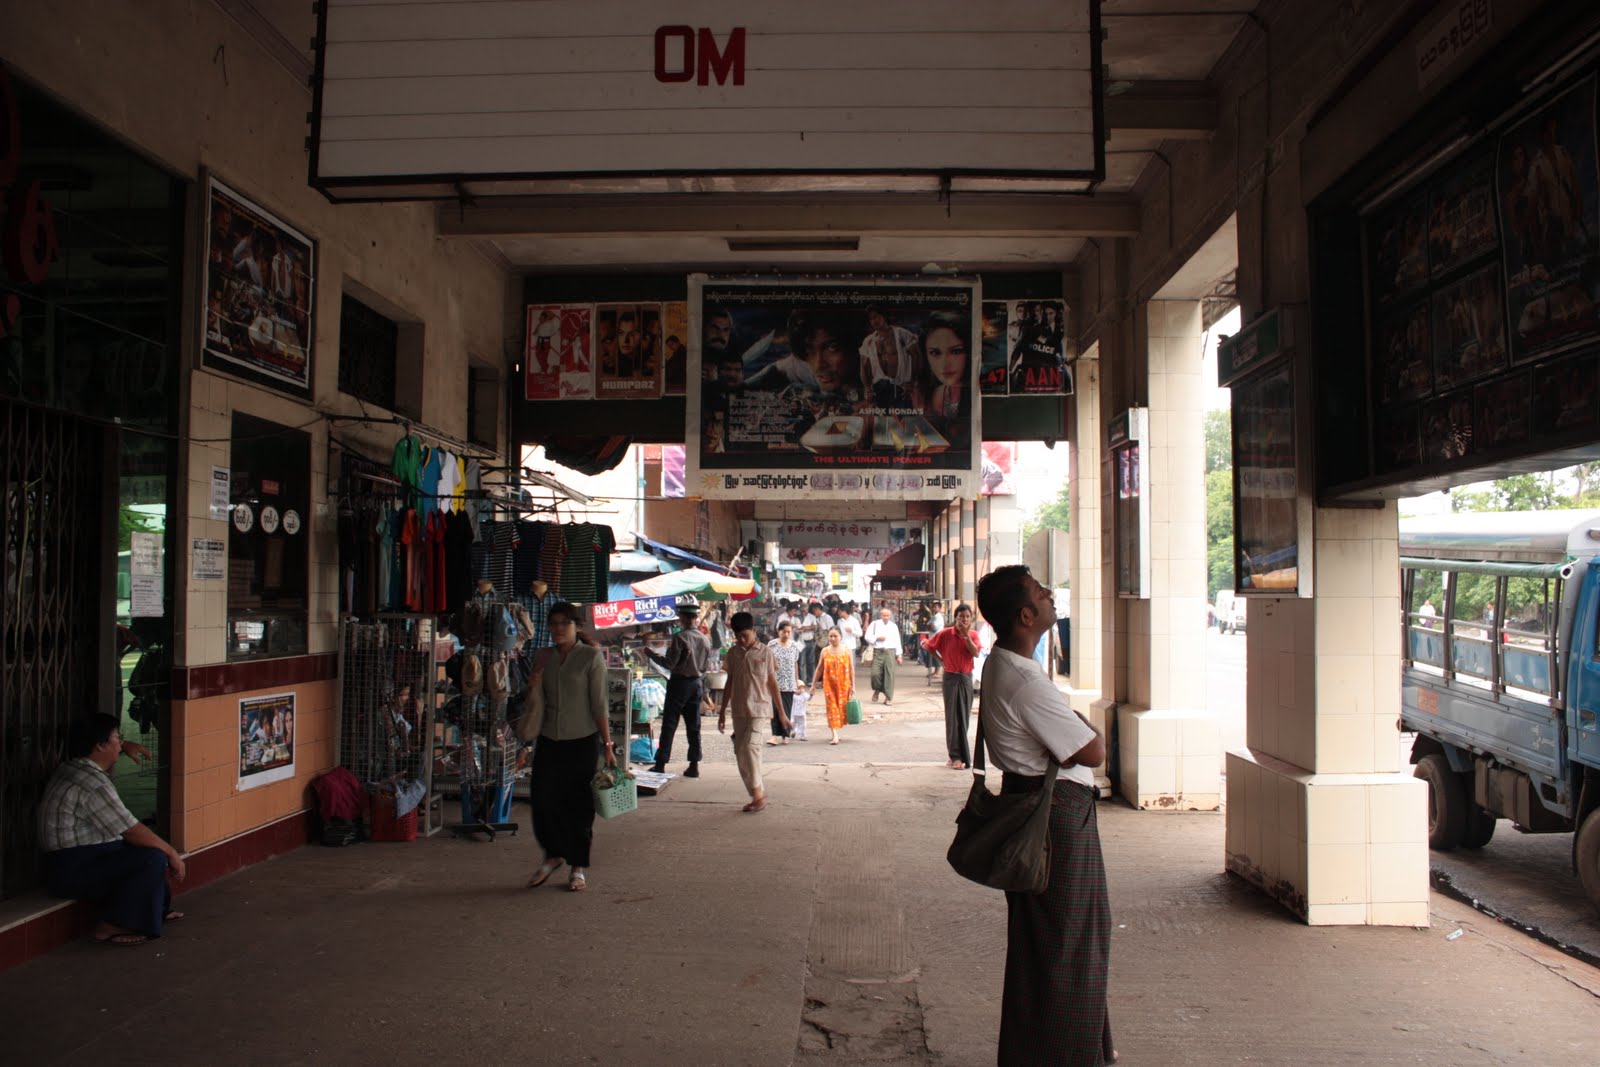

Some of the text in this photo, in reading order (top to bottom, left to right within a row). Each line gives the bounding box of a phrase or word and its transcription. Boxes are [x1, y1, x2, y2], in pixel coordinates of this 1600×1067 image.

[654, 25, 746, 86] OM
[1025, 367, 1061, 385] AAN
[888, 407, 924, 416] HONDA'S
[800, 415, 951, 454] OM
[814, 456, 932, 465] THE ULTIMATE POWER
